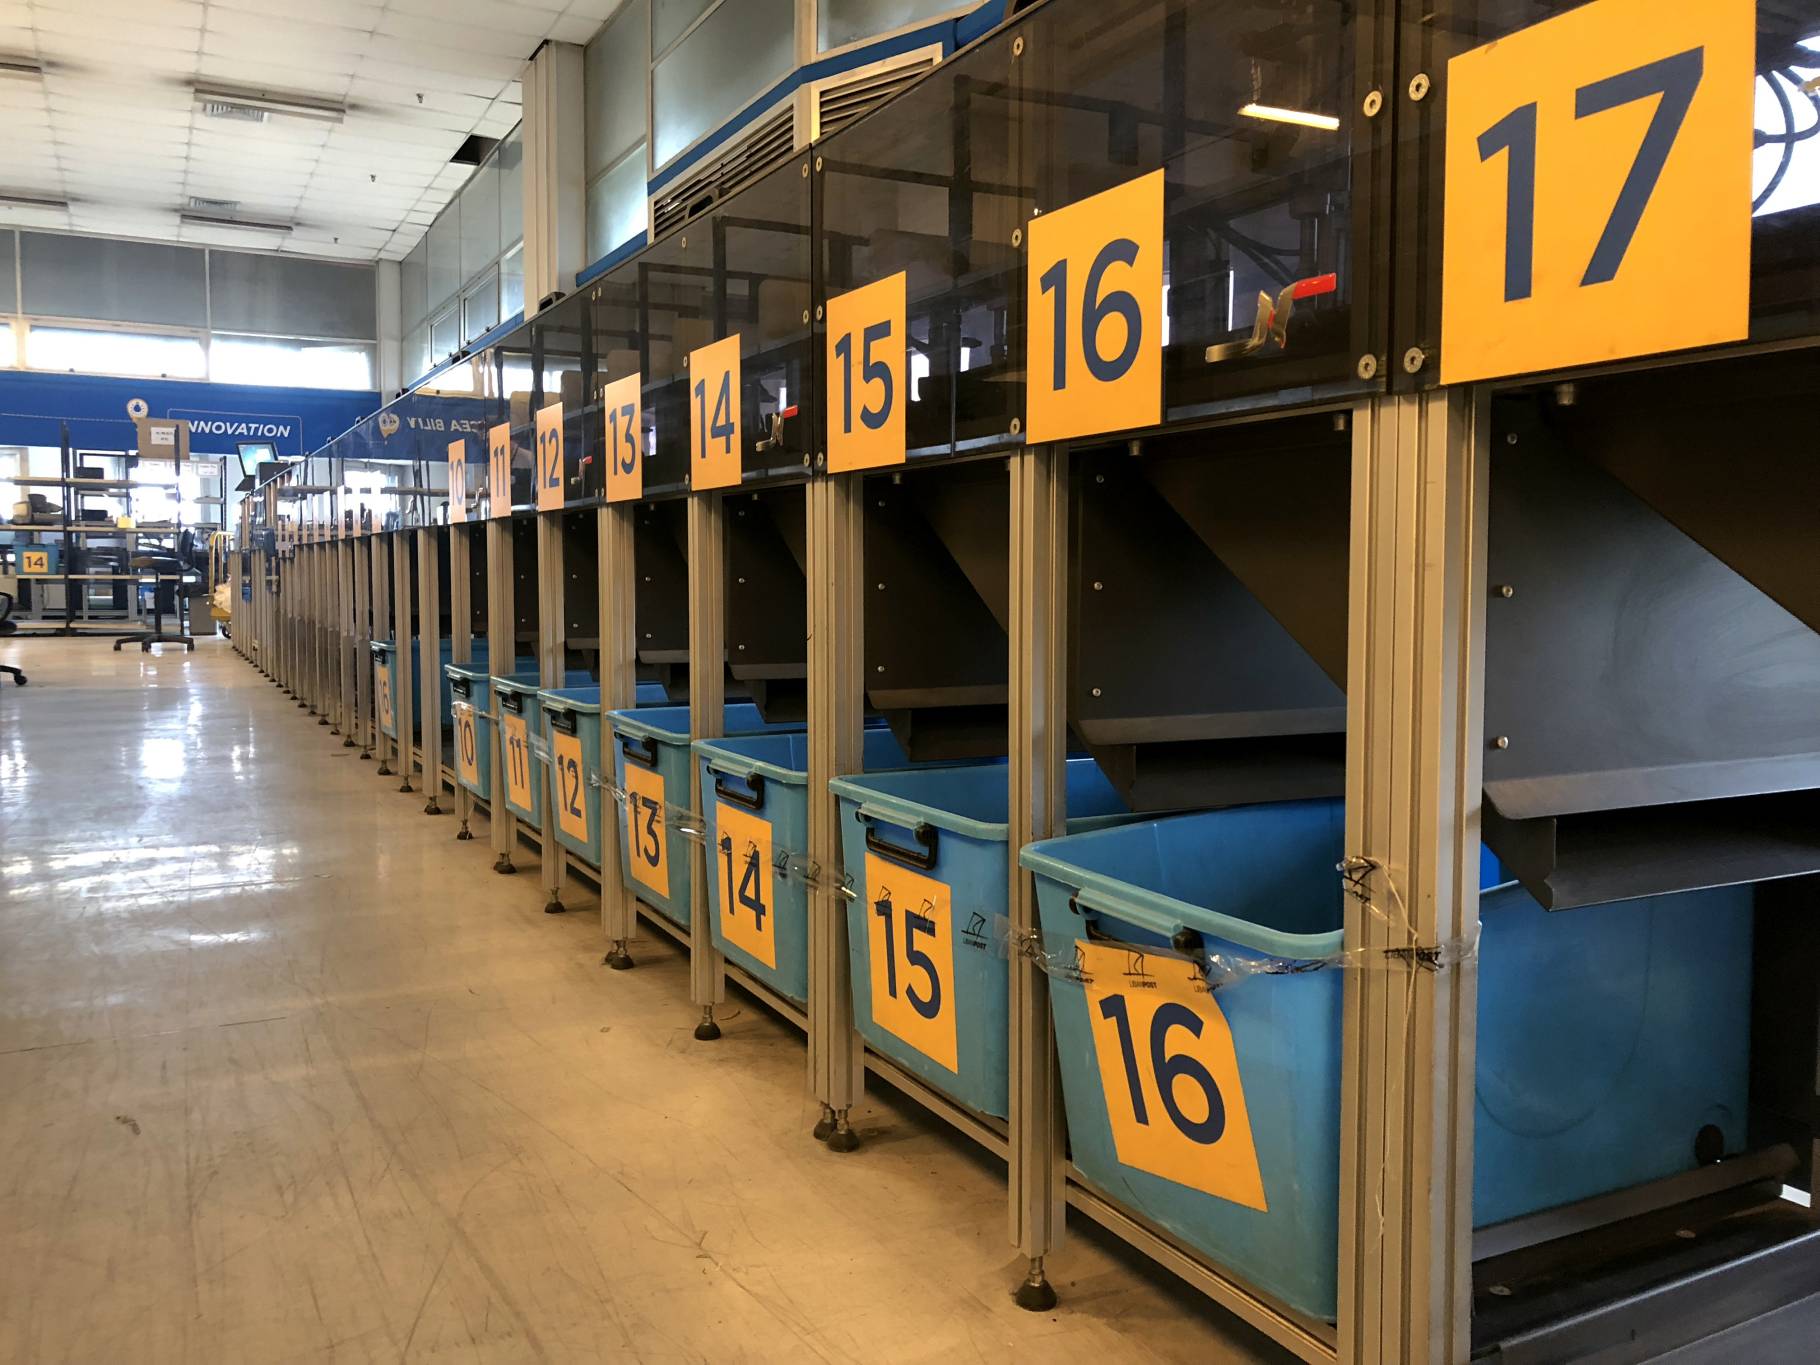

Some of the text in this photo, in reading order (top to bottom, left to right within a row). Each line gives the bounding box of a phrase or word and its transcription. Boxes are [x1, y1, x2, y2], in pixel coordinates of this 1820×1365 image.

[1477, 45, 1704, 303] 17
[1040, 238, 1142, 391] 16
[834, 319, 894, 435] 15
[188, 420, 290, 438] NNOVATION
[608, 401, 636, 476] 13
[694, 370, 735, 460] 14
[450, 458, 464, 506] 10
[493, 444, 506, 498] 11
[540, 429, 561, 489] 12
[24, 556, 44, 568] 14
[458, 717, 474, 766] 10
[510, 735, 525, 790] 11
[558, 754, 582, 819] 12
[630, 792, 660, 867] 13
[721, 836, 766, 932] 14
[875, 901, 941, 1019] 15
[1099, 993, 1226, 1145] 16
